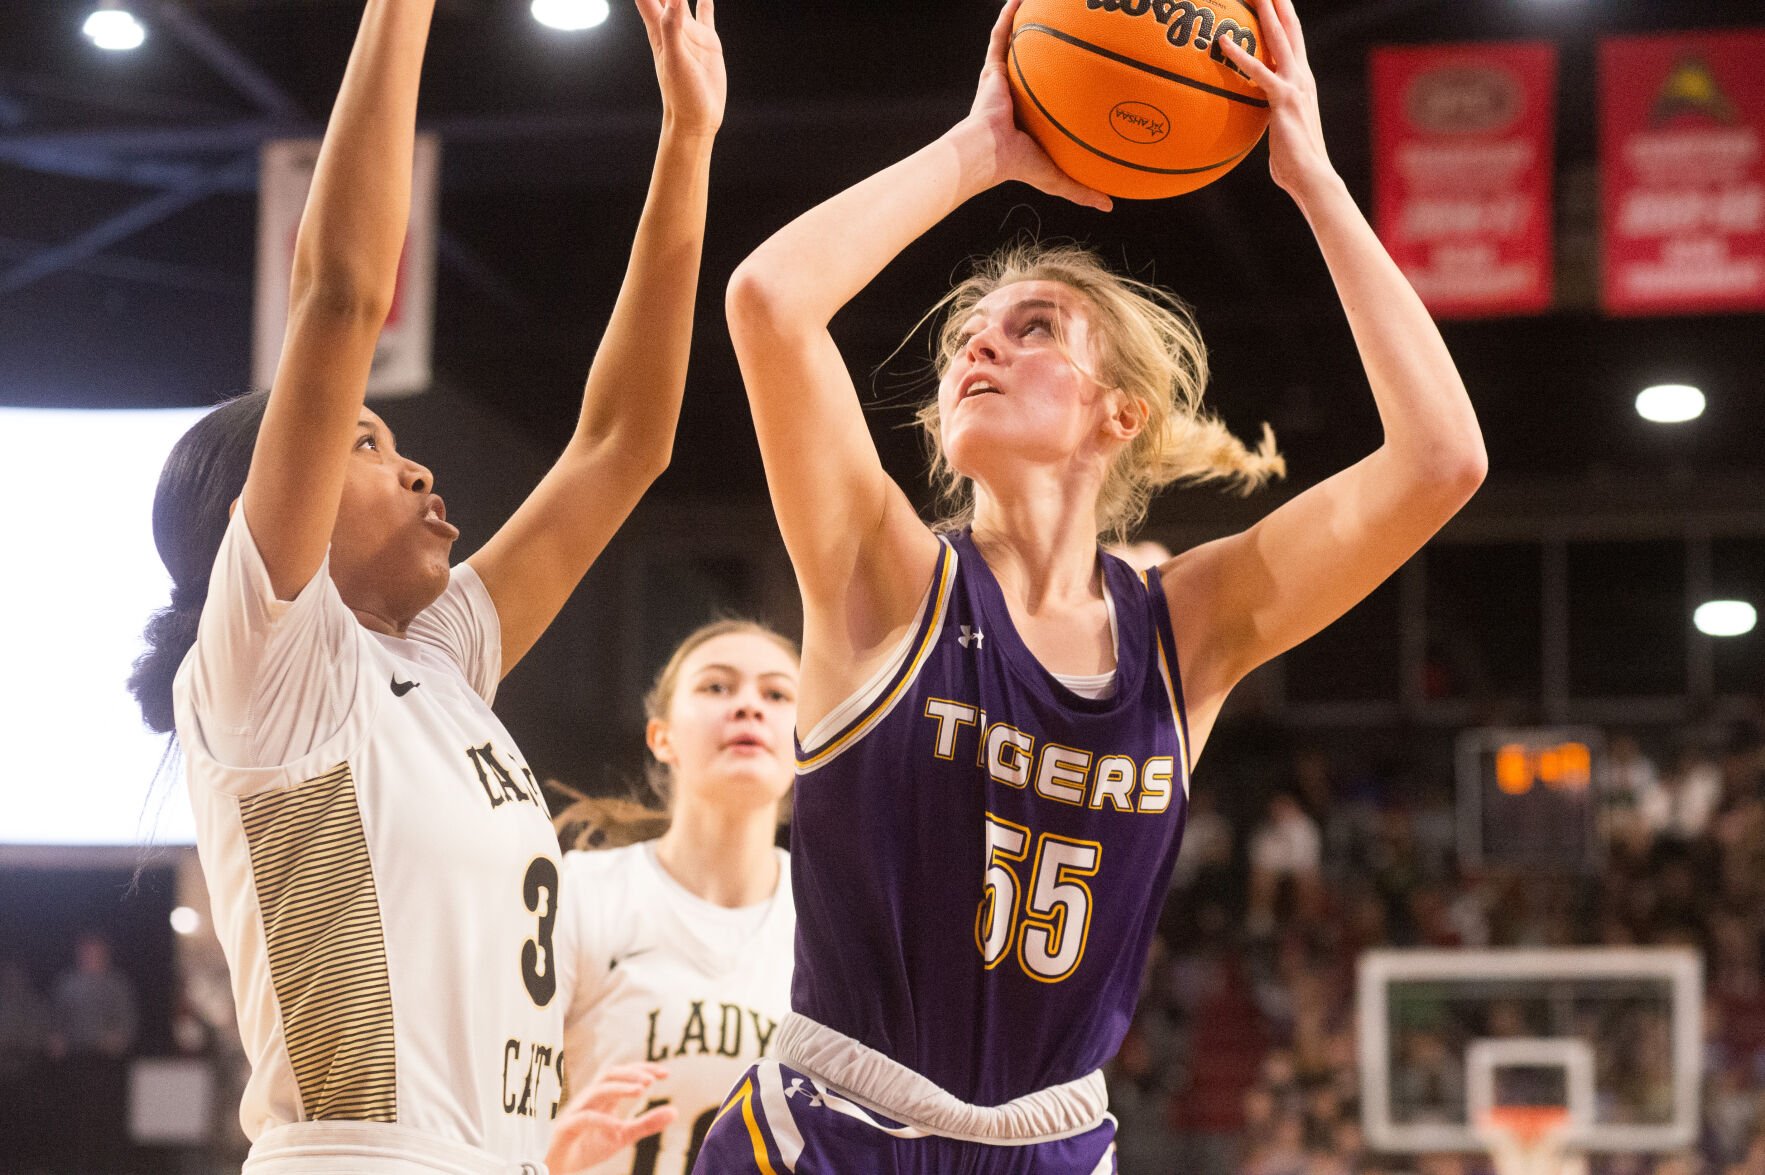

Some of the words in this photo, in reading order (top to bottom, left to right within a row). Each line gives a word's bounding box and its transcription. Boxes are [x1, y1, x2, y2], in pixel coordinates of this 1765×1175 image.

[466, 741, 553, 822] LA
[521, 853, 559, 1007] 3
[975, 811, 1103, 984] 55
[646, 1000, 777, 1062] LADY
